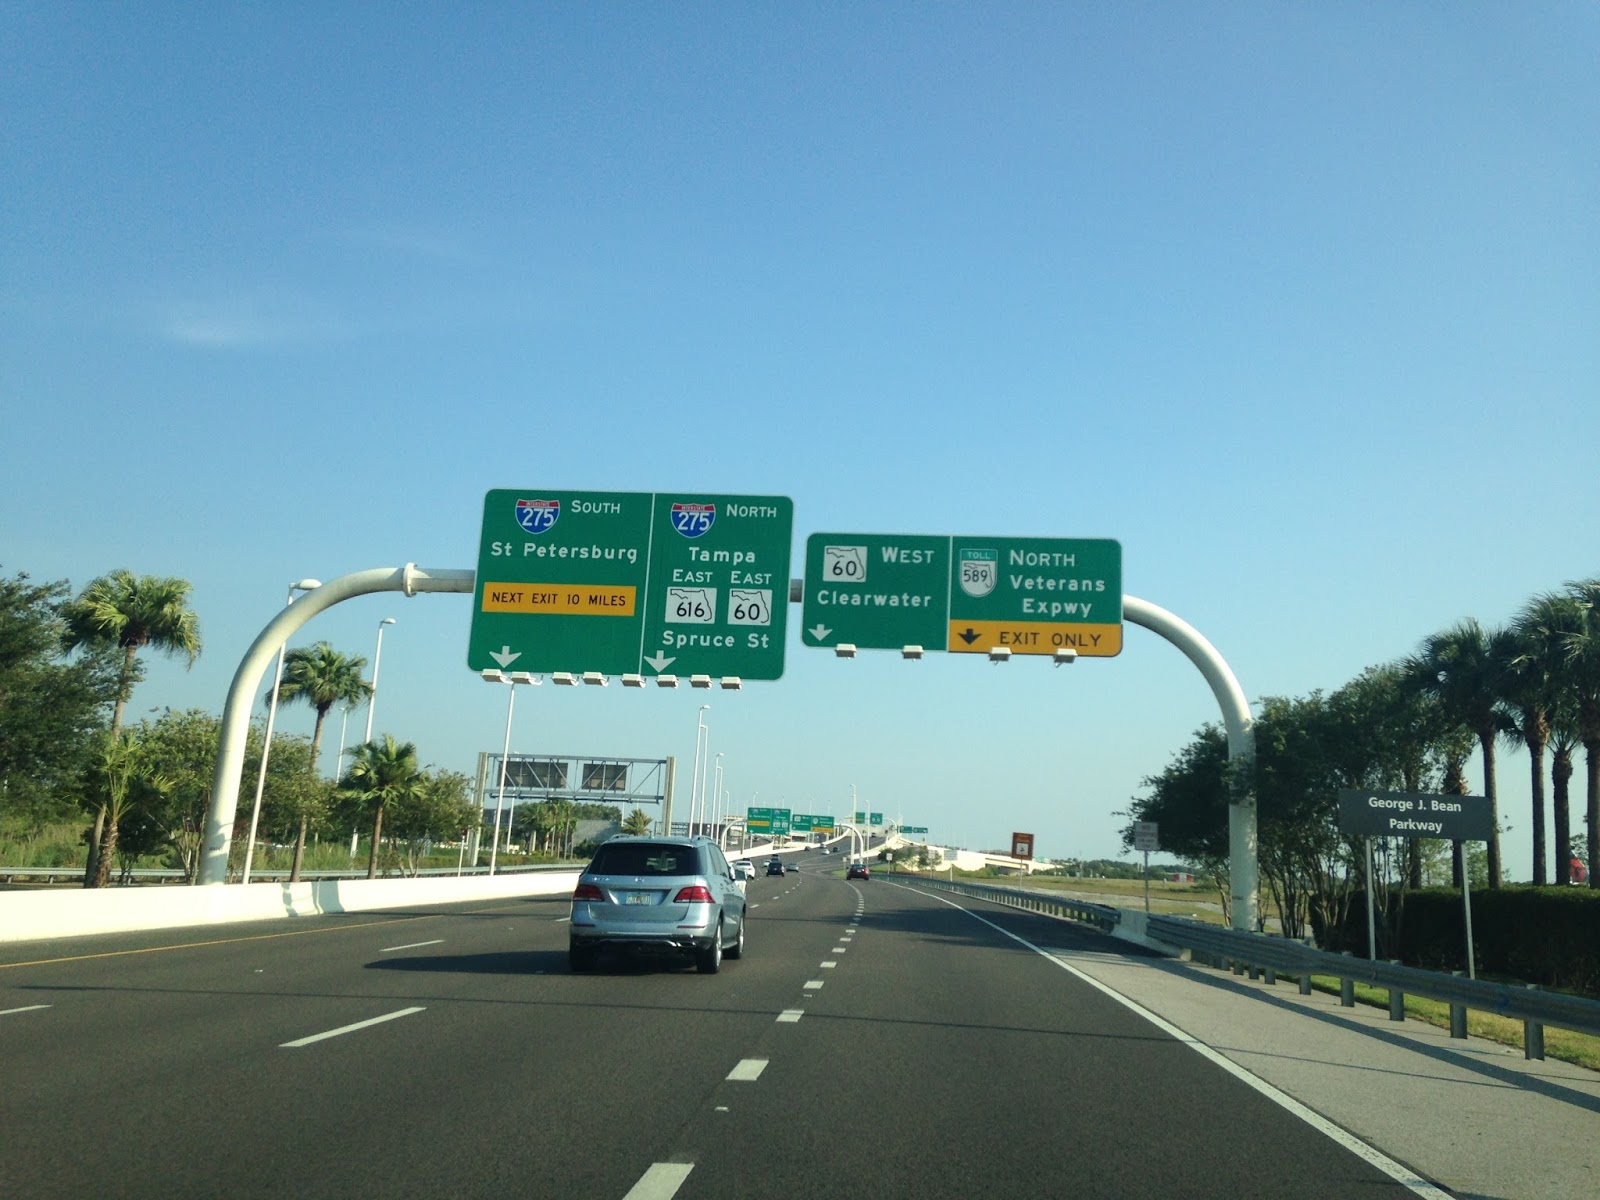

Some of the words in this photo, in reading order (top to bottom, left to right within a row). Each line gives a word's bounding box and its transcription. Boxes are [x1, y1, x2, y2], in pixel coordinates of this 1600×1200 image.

[571, 500, 620, 514] SOUTH
[726, 504, 777, 518] NORTH
[522, 508, 555, 527] 275
[677, 512, 710, 531] 275
[490, 542, 512, 557] St
[523, 543, 638, 564] Petersburg
[689, 547, 755, 565] Tampa
[882, 547, 934, 563] WEST
[967, 552, 991, 560] TOLL
[1010, 550, 1075, 566] NORTH
[672, 569, 713, 583] EAST
[832, 561, 857, 576] 60
[963, 569, 988, 584] 589
[730, 571, 772, 585] EAST
[1010, 575, 1106, 592] Veterans
[491, 592, 524, 604] NEXT
[532, 593, 558, 605] EXIT
[567, 594, 580, 606] 10
[588, 594, 626, 607] MILES
[817, 590, 931, 607] Clearwater
[676, 602, 705, 618] 616
[734, 604, 760, 620] 60
[1022, 598, 1093, 618] Expwy
[662, 630, 735, 648] Spruce
[748, 633, 770, 649] St
[1000, 631, 1041, 646] EXIT
[1051, 633, 1102, 648] ONLY
[1368, 797, 1413, 812] George
[1418, 800, 1426, 810] J.
[1431, 800, 1462, 812] Bean
[1389, 818, 1443, 834] Parkway
